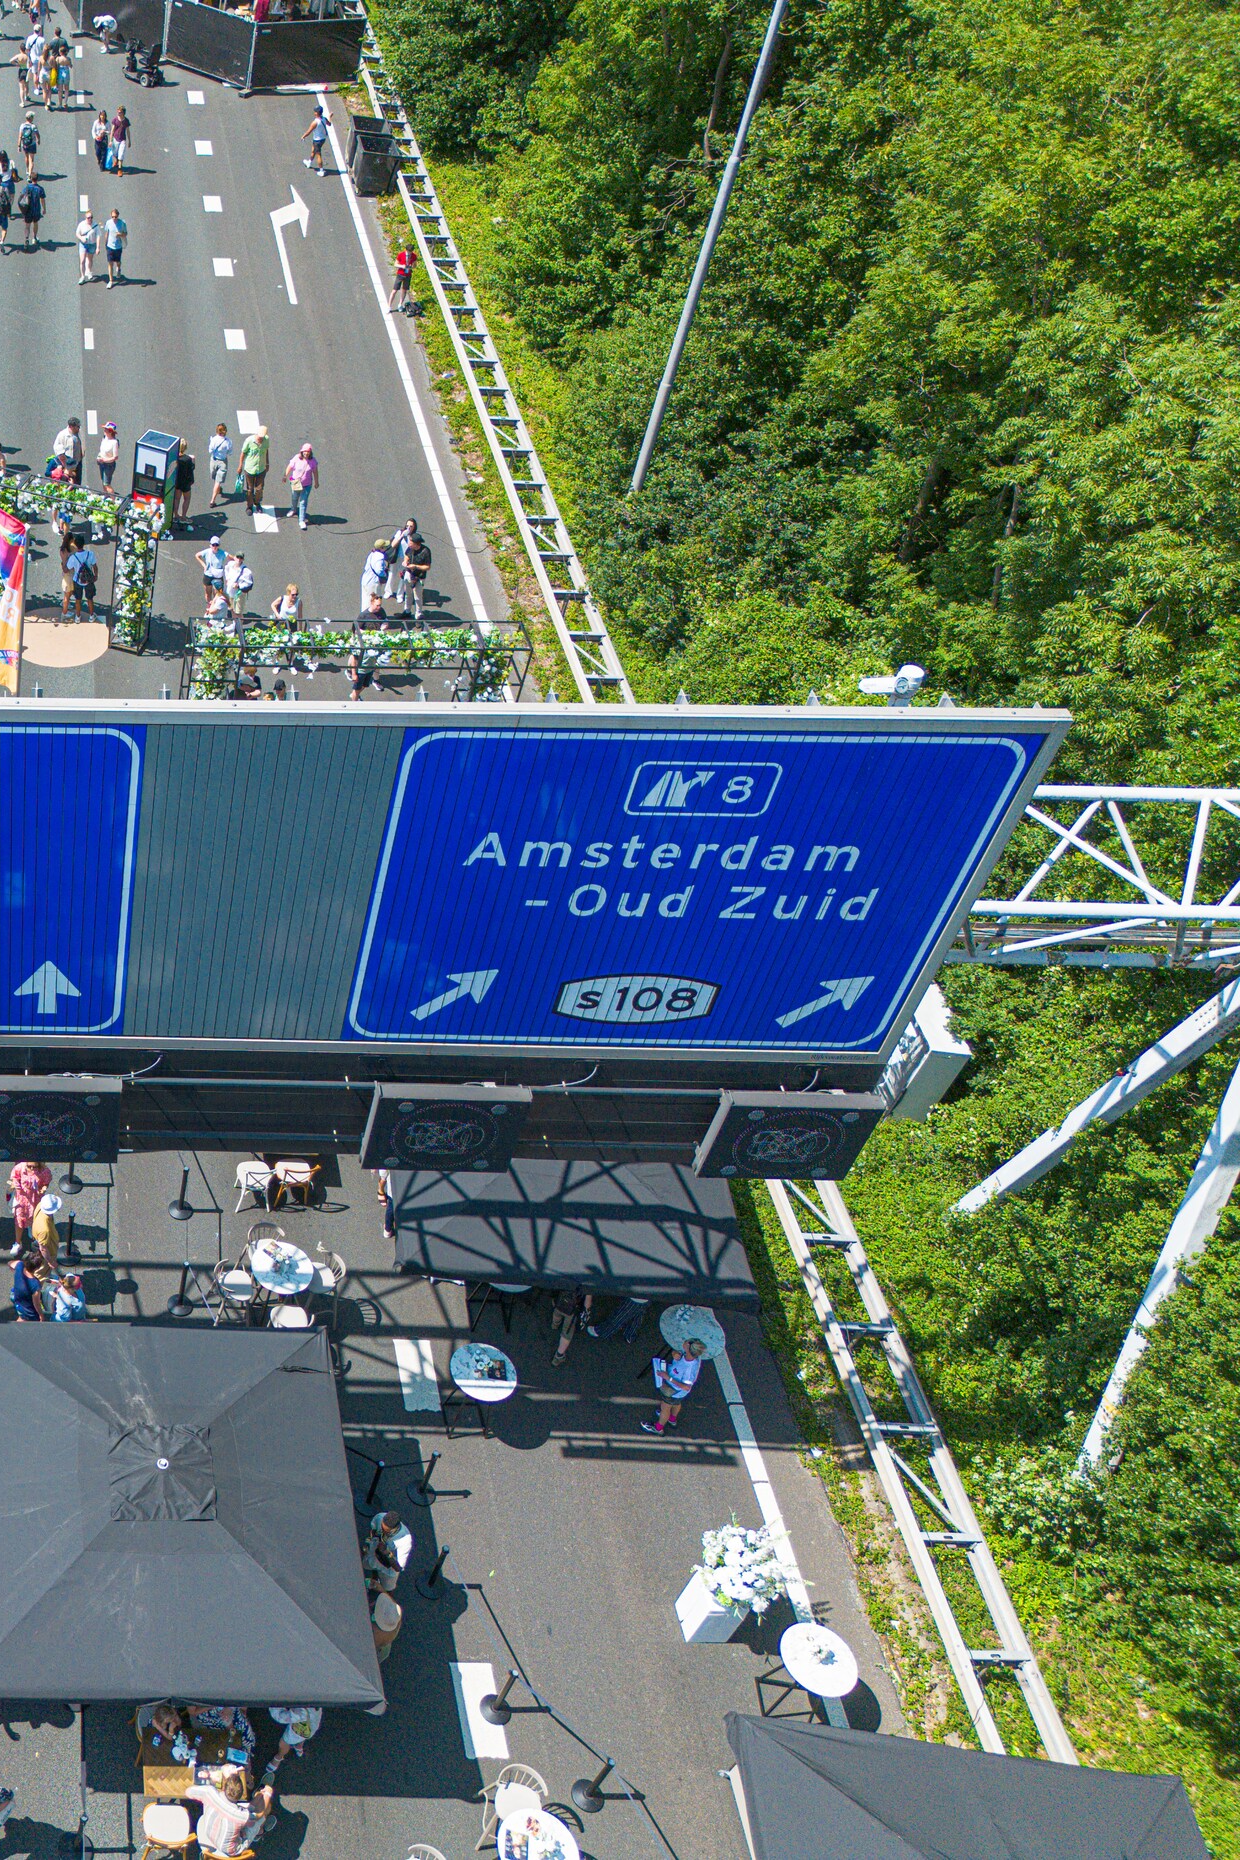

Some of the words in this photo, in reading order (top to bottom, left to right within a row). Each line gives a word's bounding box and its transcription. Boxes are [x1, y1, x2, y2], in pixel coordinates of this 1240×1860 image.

[720, 776, 754, 804] 8
[462, 832, 861, 872] Amsterdam
[717, 886, 881, 922] Zuid
